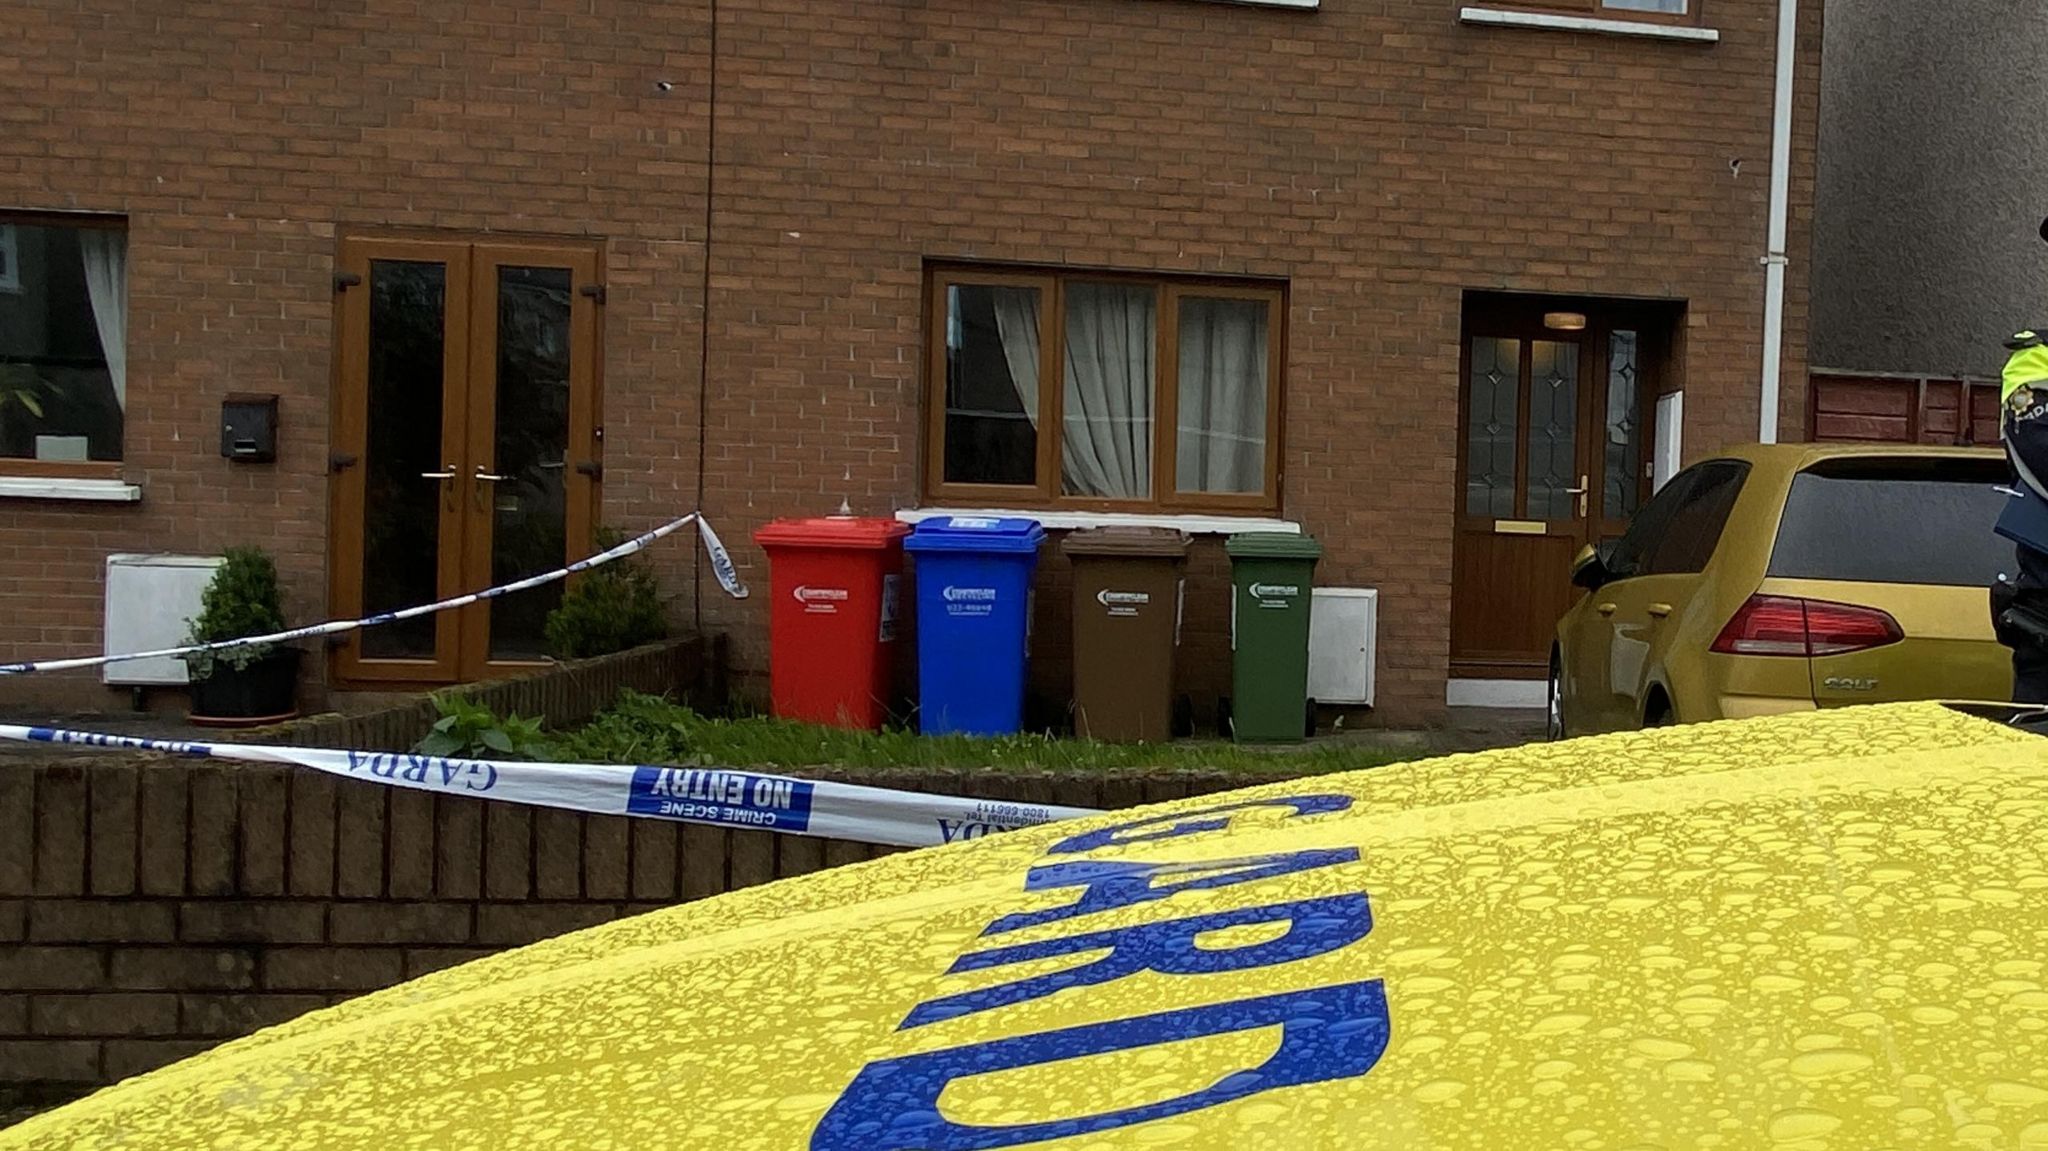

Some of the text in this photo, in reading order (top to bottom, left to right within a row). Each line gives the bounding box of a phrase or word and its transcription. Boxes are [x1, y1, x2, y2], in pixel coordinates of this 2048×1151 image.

[347, 751, 498, 791] GARDA
[651, 768, 793, 809] NO ENTRY
[660, 801, 777, 825] CRIME SCENE
